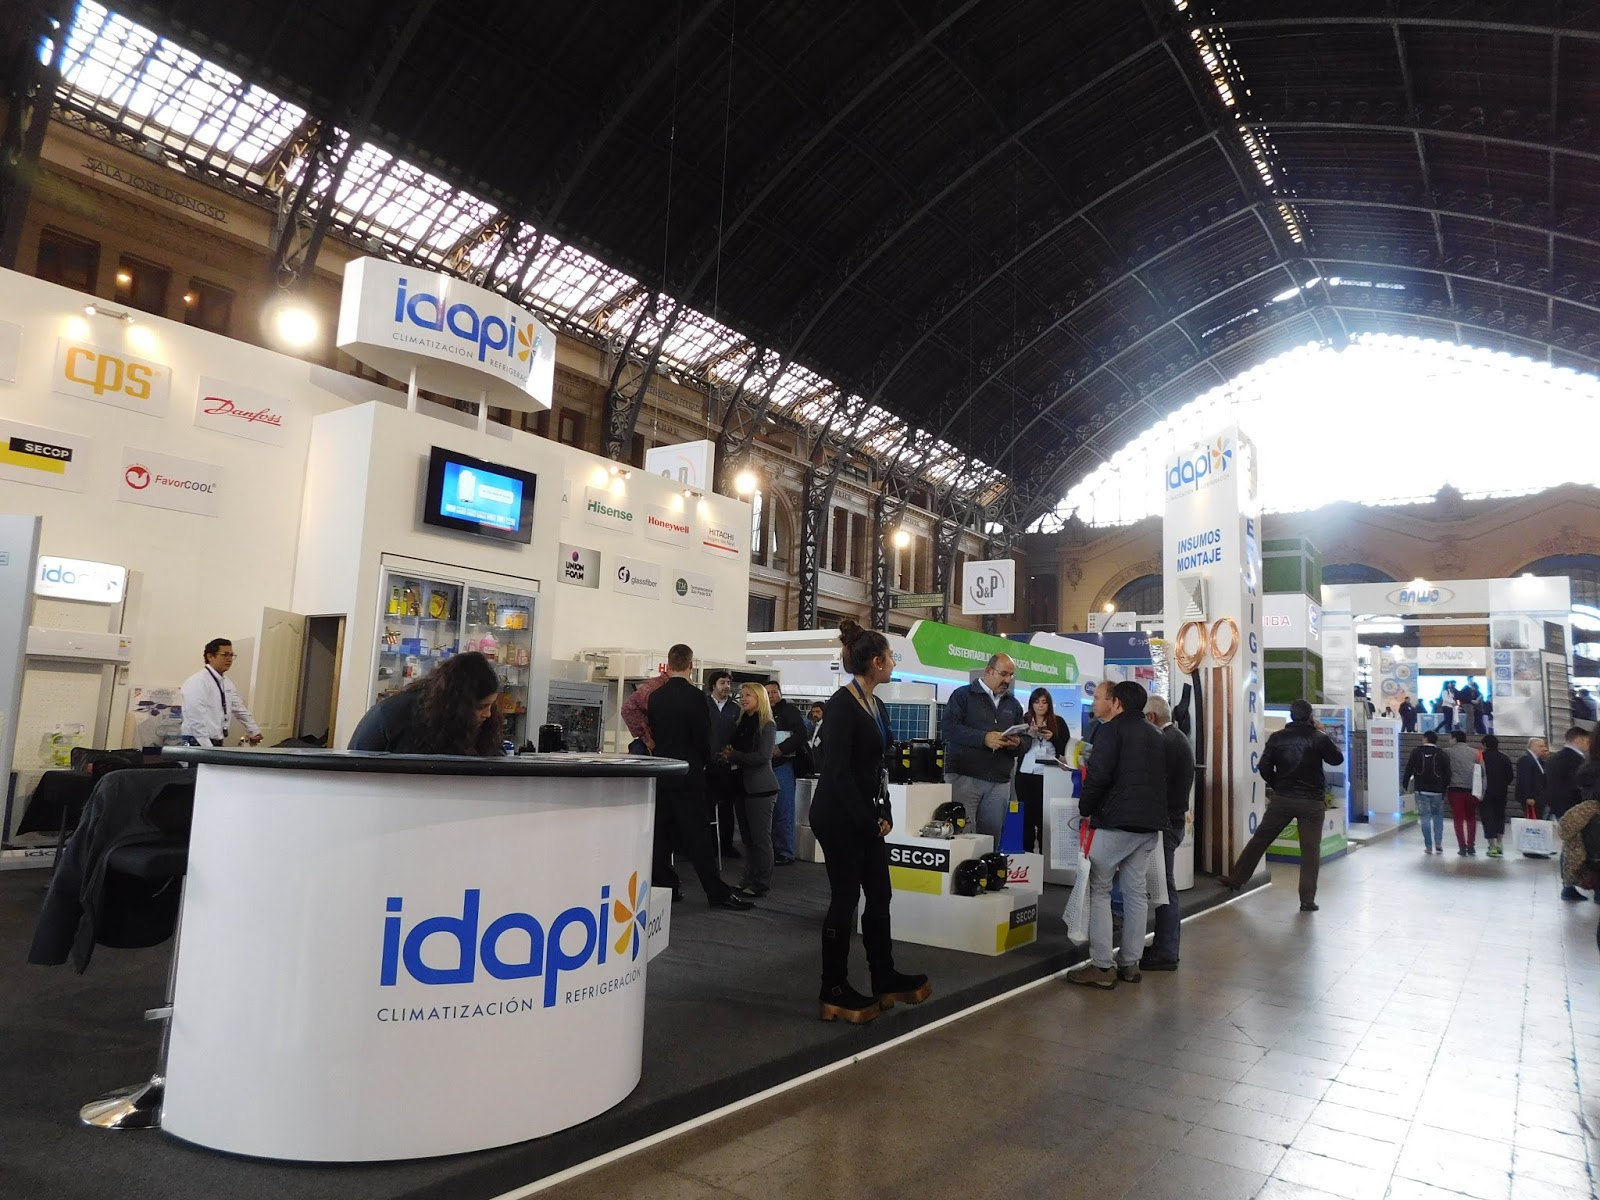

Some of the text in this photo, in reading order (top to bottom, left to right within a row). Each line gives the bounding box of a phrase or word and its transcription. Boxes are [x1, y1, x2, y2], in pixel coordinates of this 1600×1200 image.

[86, 156, 122, 180] SALA
[164, 188, 227, 222] DONOSO
[490, 358, 528, 382] REFRIGERAC
[203, 396, 282, 427] Danfoss
[25, 442, 70, 459] SECOP
[1165, 445, 1212, 491] idapi
[587, 499, 633, 521] Hisense
[648, 515, 690, 534] Honeywell
[708, 528, 735, 541] HITACHI
[1178, 528, 1221, 554] INSUMOS
[565, 561, 584, 571] UNION
[1177, 547, 1221, 573] MONTAJE
[565, 570, 584, 580] FOAM
[631, 577, 657, 588] glassfiber
[976, 575, 998, 599] S&P
[1263, 615, 1291, 627] IBA
[890, 848, 946, 867] SECOP
[1007, 859, 1030, 880] oss
[1015, 908, 1036, 924] SECOP
[380, 885, 610, 1008] idapi
[376, 966, 641, 1022] CLIMATIZACIÓN REFRIGERACIÓN
